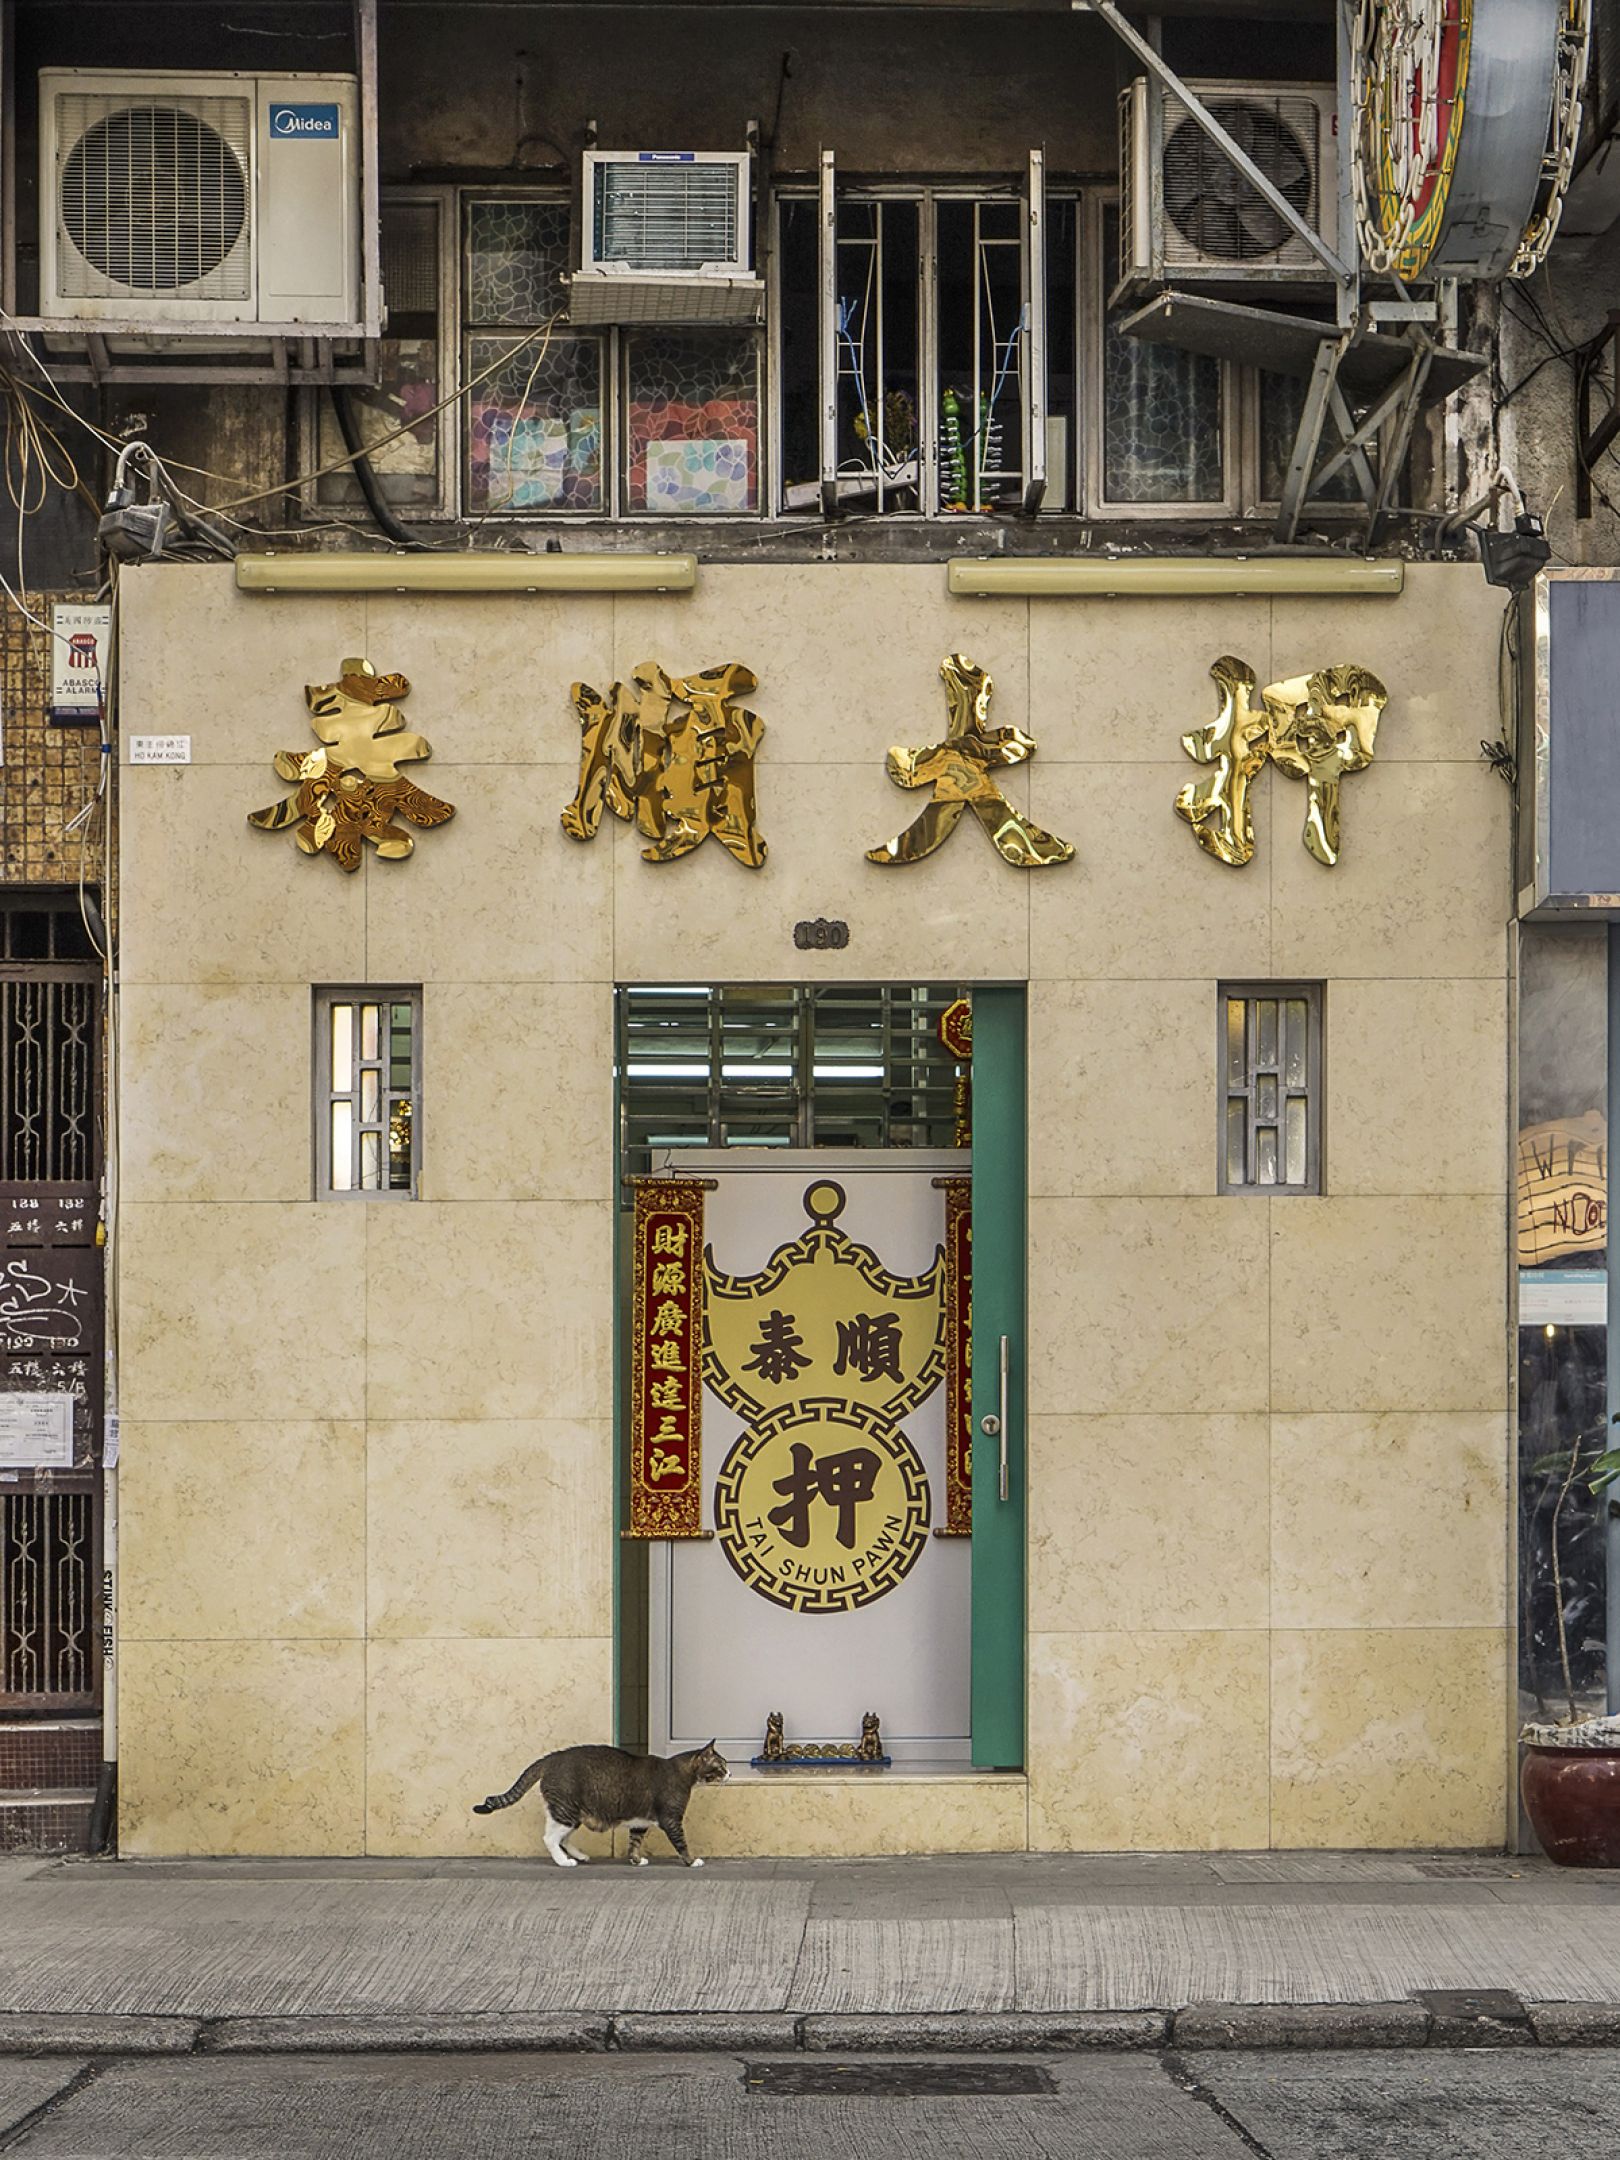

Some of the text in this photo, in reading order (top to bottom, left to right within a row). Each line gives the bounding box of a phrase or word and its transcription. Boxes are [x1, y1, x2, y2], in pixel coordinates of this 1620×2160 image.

[275, 109, 332, 134] Midea
[799, 926, 843, 946] 190
[767, 1443, 883, 1549] 押
[746, 1515, 902, 1585] TAI SHUN PAWN
